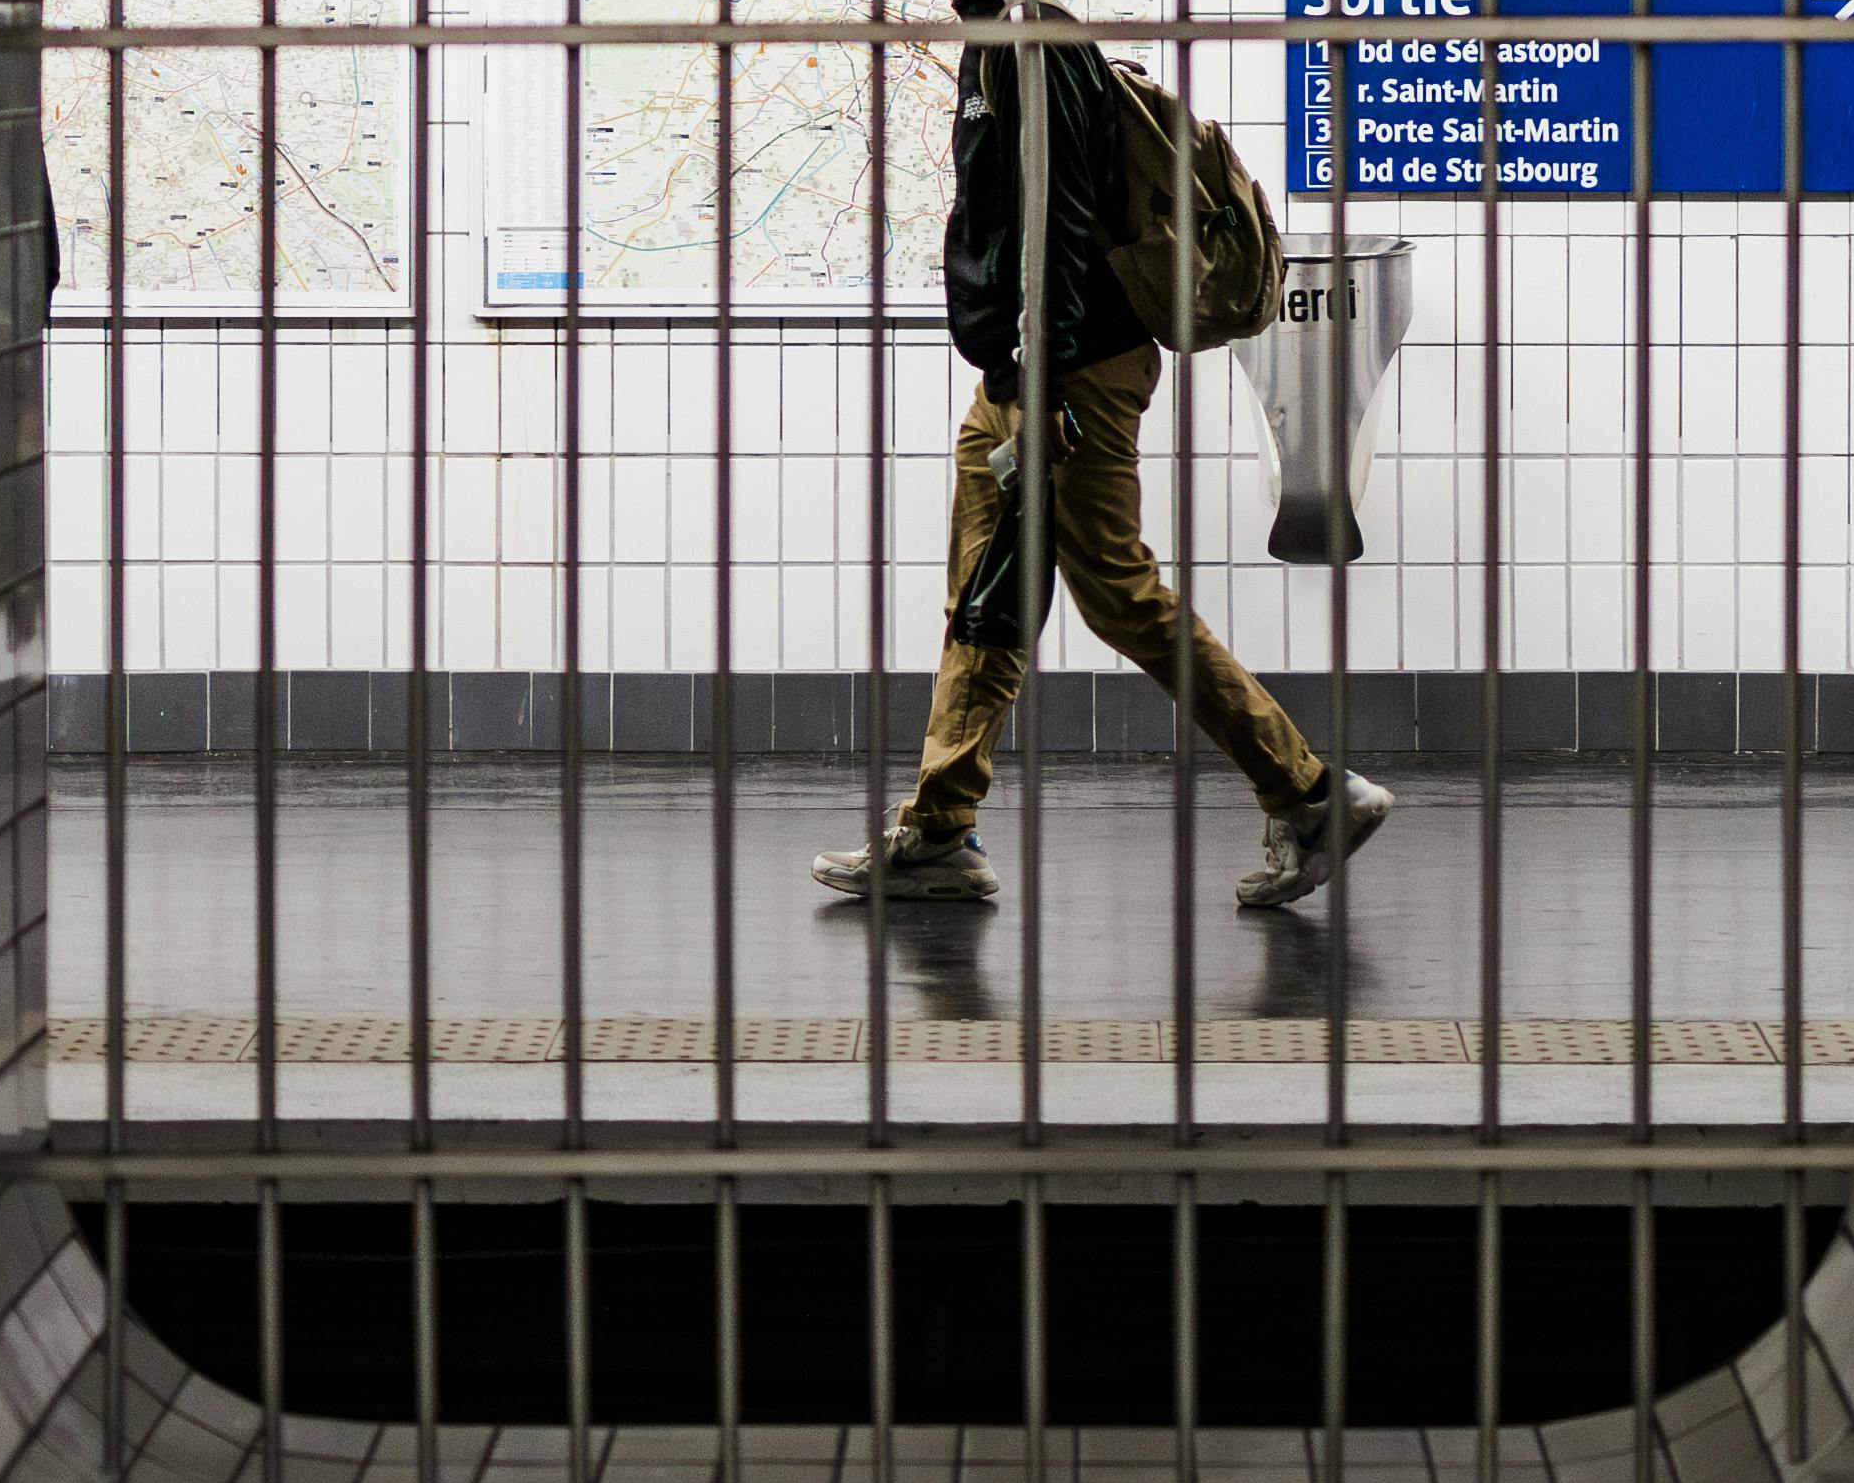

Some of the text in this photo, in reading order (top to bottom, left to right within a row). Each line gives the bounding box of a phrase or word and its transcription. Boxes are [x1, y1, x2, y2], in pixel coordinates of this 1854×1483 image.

[1316, 39, 1329, 63] 1
[1358, 38, 1393, 63] bd
[1402, 38, 1437, 63] de
[1314, 78, 1558, 103] 2 r. Saint-Martin
[1315, 119, 1332, 143] 3
[1358, 118, 1433, 143] Porte
[1316, 158, 1333, 183] 6
[1359, 157, 1393, 183] bd
[1402, 157, 1437, 183] de
[1279, 278, 1357, 323] eri
